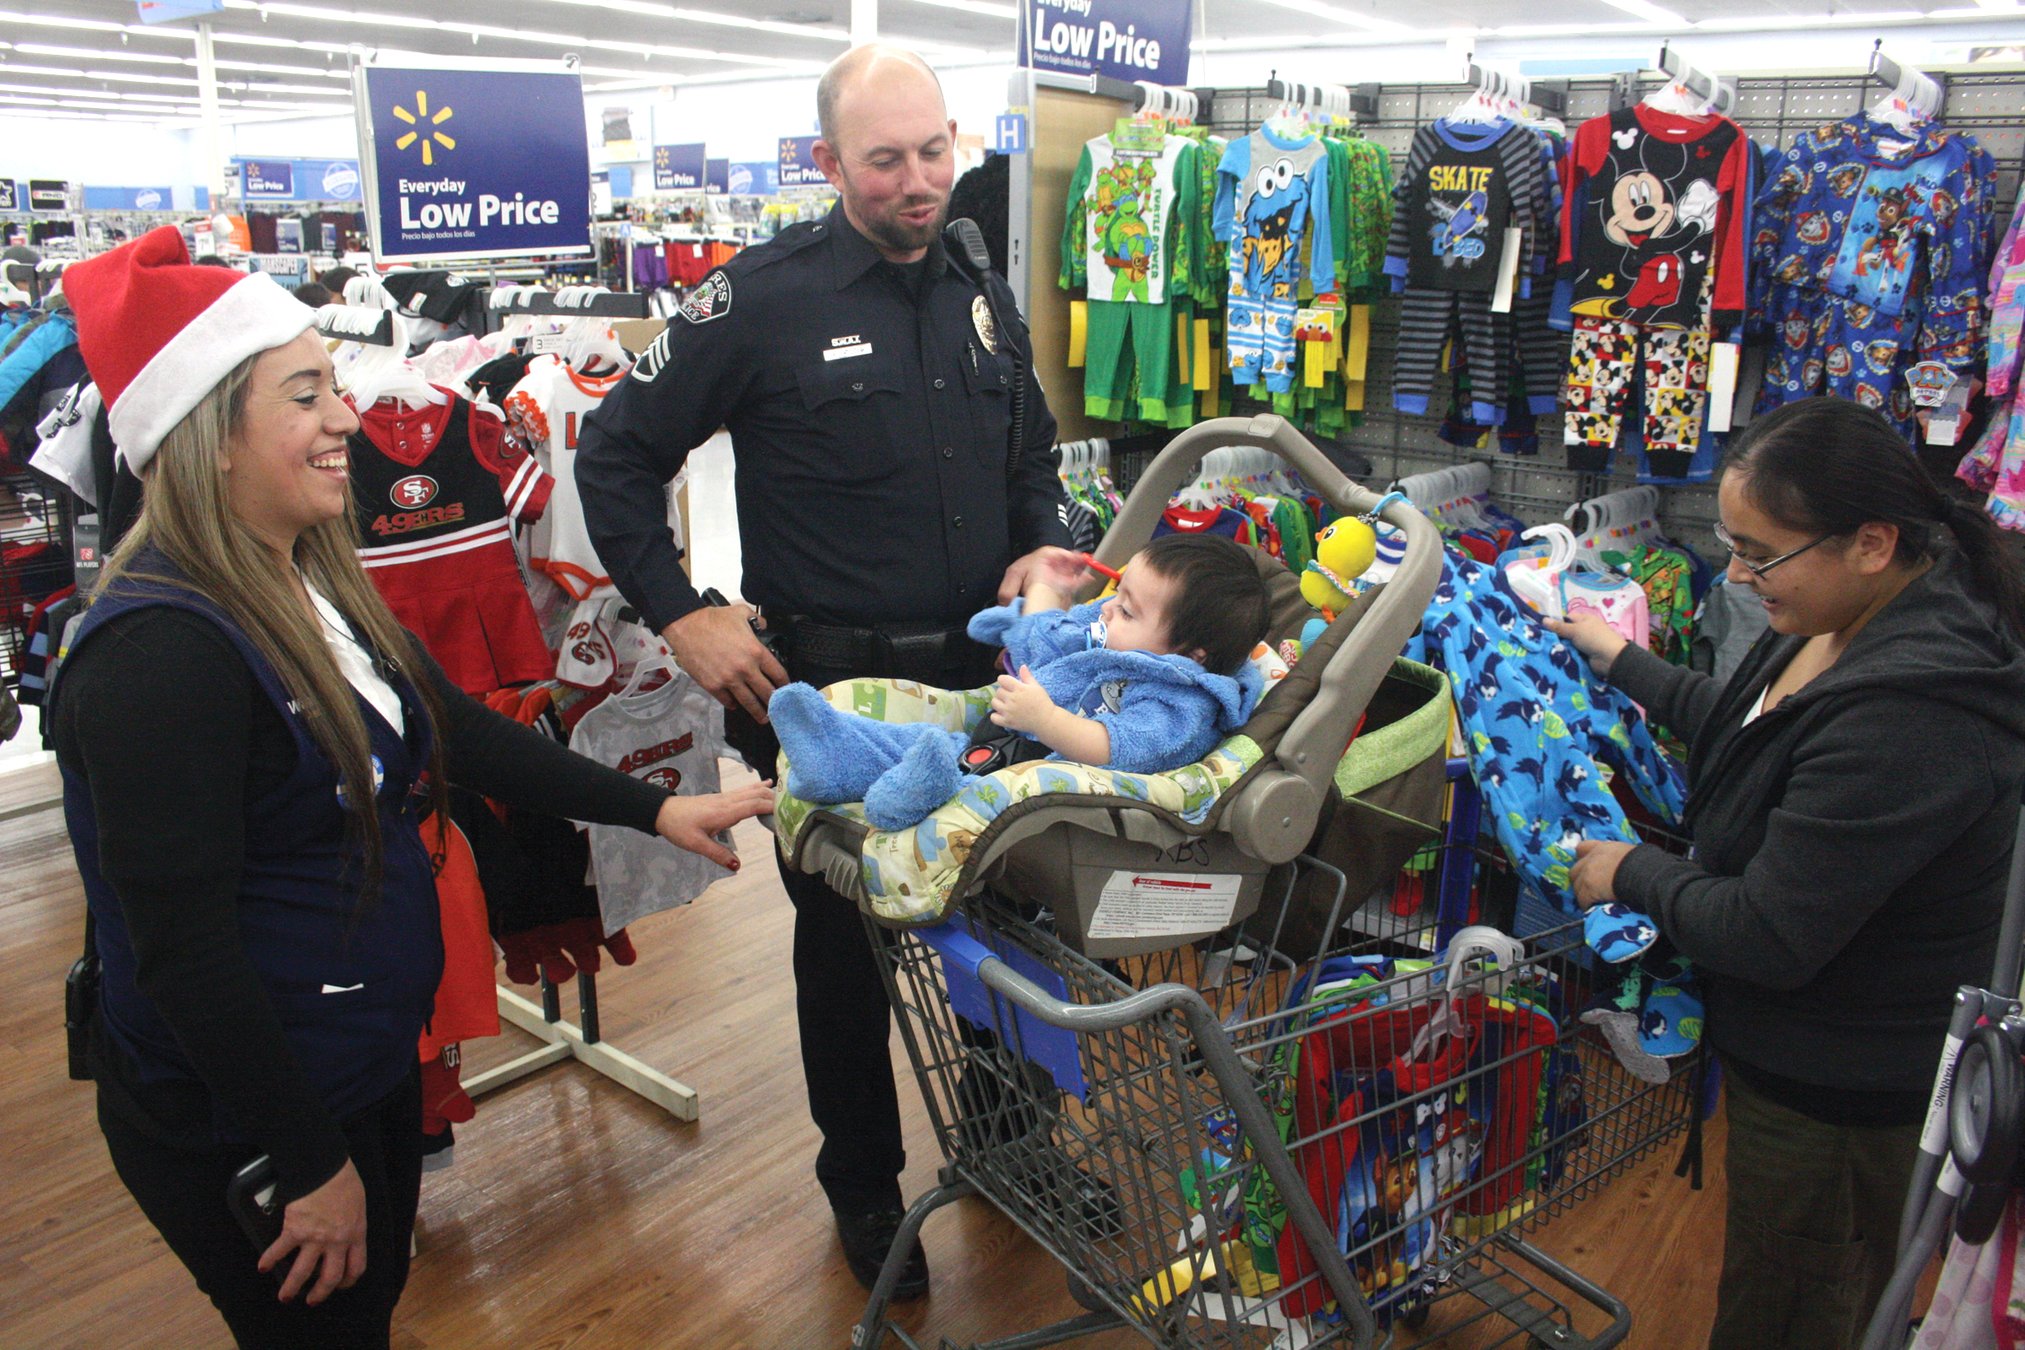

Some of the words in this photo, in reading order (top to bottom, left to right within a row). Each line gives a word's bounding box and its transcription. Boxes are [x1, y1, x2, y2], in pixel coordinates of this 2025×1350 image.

[1034, 8, 1094, 58] Low
[1097, 21, 1160, 70] Price
[1001, 118, 1019, 149] H
[399, 177, 466, 196] Everyday
[657, 175, 674, 186] Low
[674, 173, 695, 186] Price
[782, 168, 801, 181] Low
[802, 167, 827, 181] Pric
[1428, 165, 1494, 192] SKATE
[400, 196, 472, 229] Low
[478, 192, 560, 226] Price
[1151, 188, 1162, 233] TURTLE
[1150, 236, 1160, 279] POWER
[371, 502, 466, 537] 49ERS
